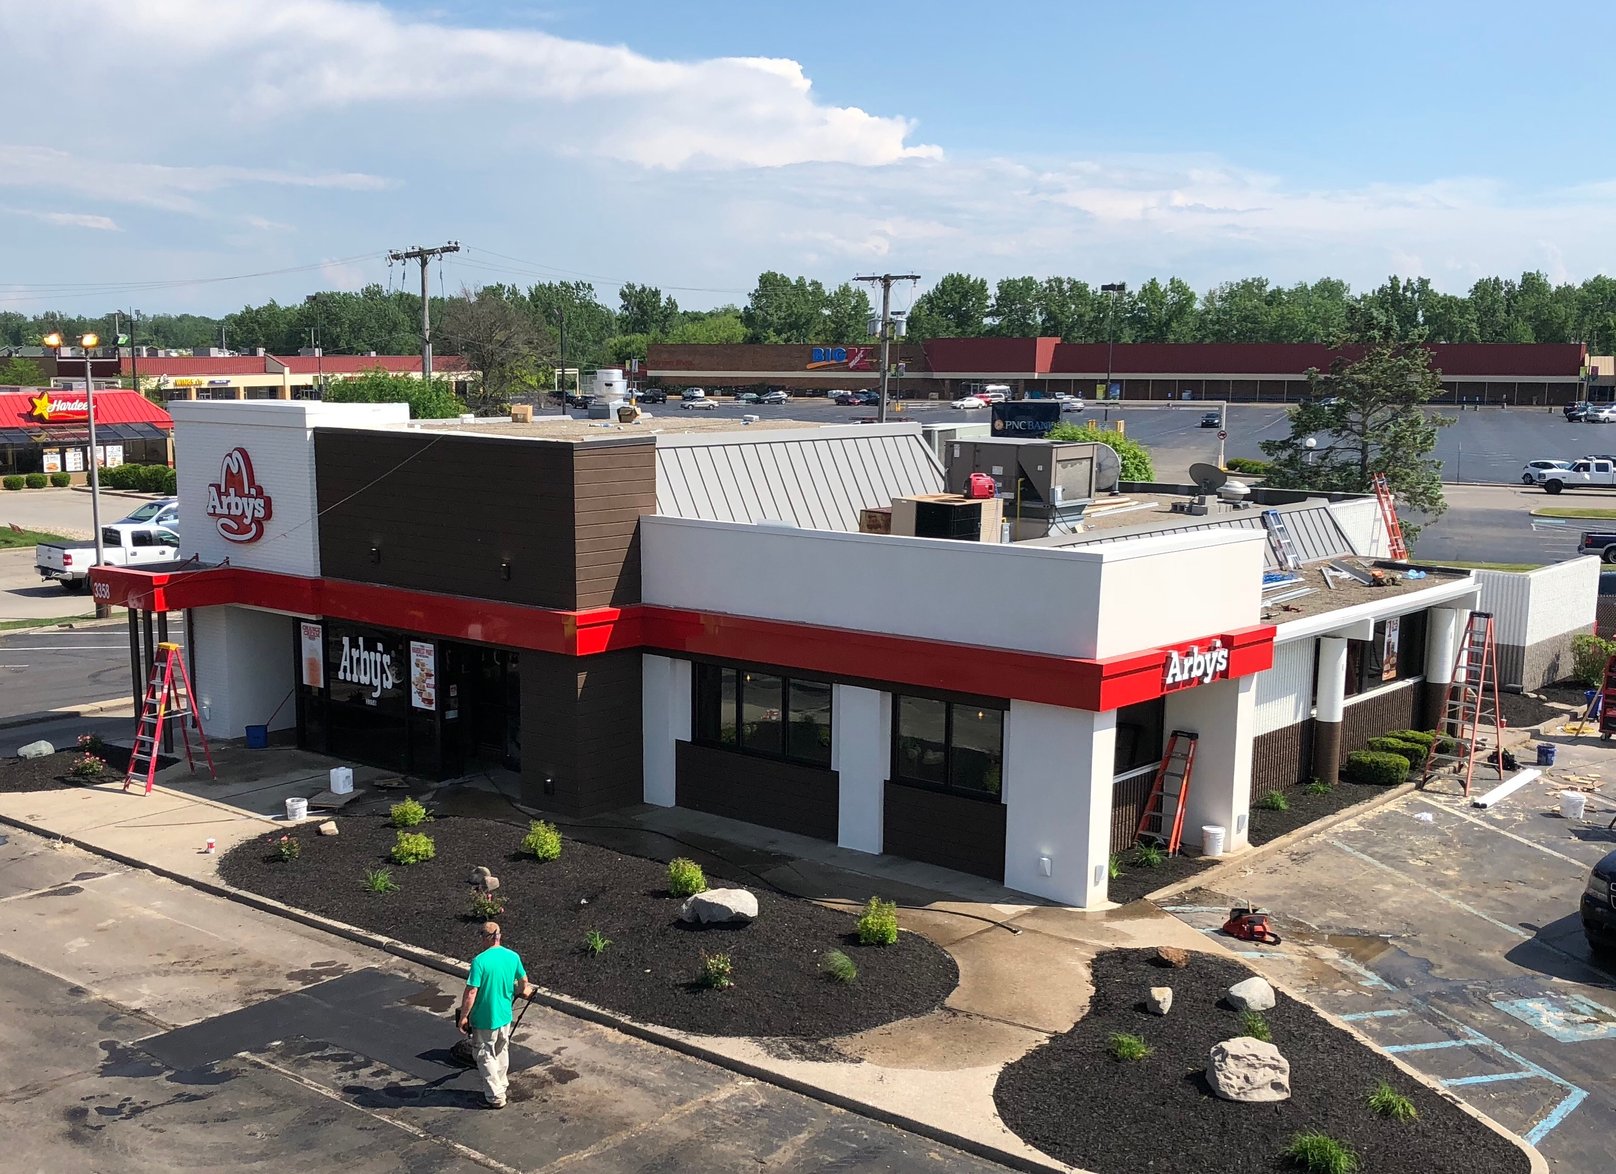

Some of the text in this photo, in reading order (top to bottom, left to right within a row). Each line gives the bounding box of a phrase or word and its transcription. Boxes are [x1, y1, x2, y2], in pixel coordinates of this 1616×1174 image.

[812, 347, 846, 362] BIG
[1005, 420, 1027, 430] PNC
[207, 486, 265, 525] Arby's
[94, 582, 110, 599] 3358
[338, 636, 393, 698] Arby's
[1165, 639, 1229, 684] Arby's
